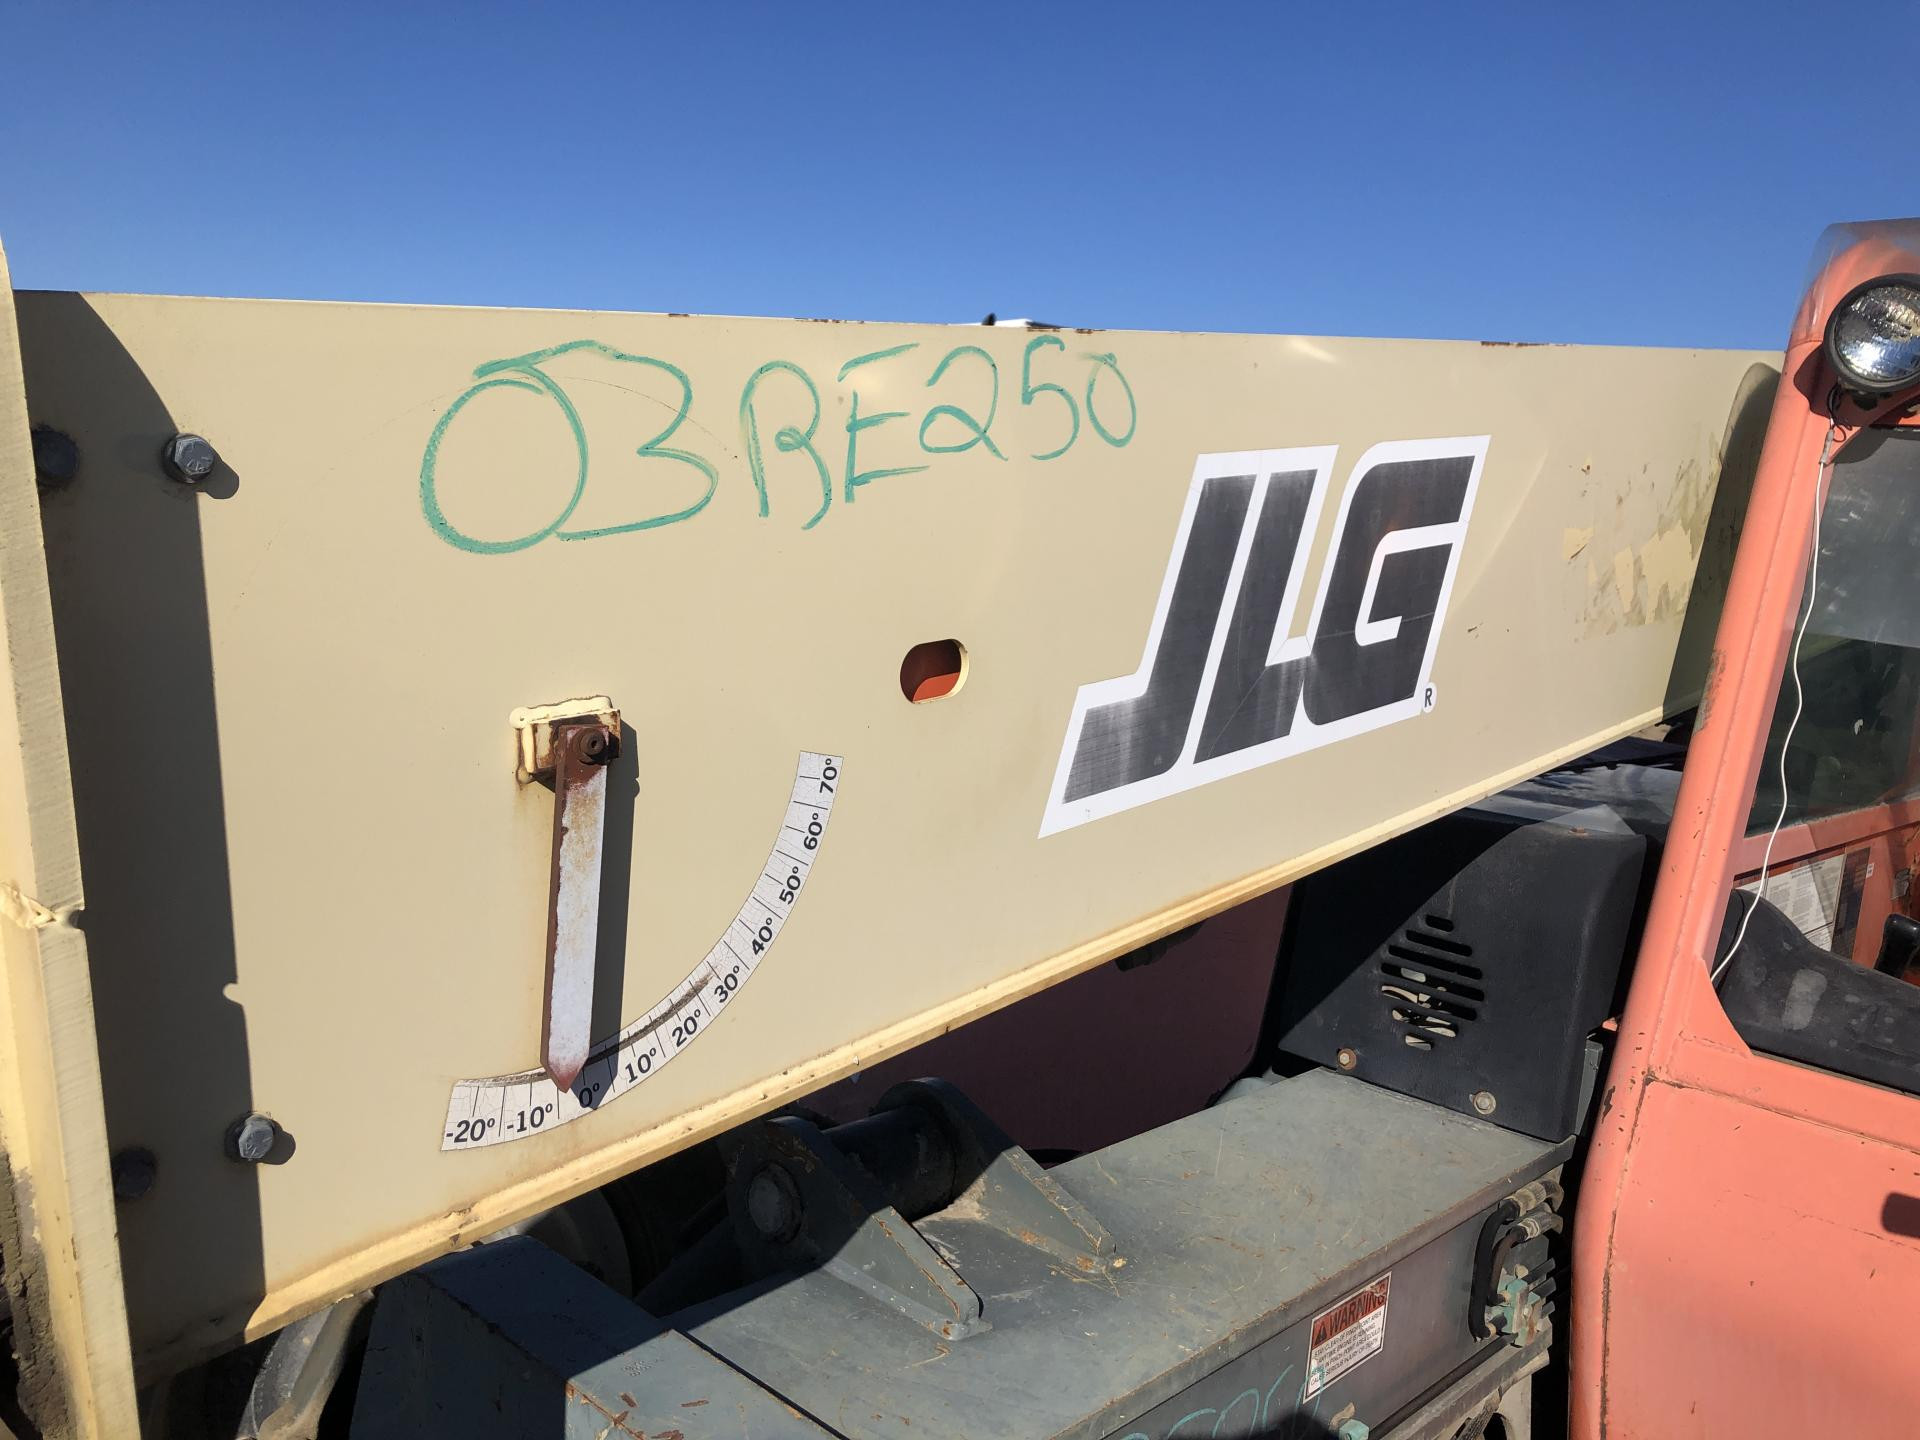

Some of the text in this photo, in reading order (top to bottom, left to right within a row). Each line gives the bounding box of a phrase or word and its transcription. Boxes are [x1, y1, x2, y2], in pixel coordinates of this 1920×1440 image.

[1038, 435, 1491, 839] JLG
[446, 1117, 496, 1143] -20°
[506, 1103, 553, 1133] -10°
[624, 1047, 657, 1084] 10°
[671, 1008, 702, 1048] 20°
[713, 965, 741, 1004] 30°
[750, 917, 774, 957] 40°
[778, 866, 802, 905] 50°
[803, 812, 824, 851] 60°
[818, 757, 838, 794] 70°
[1329, 1283, 1386, 1336] WARNING
